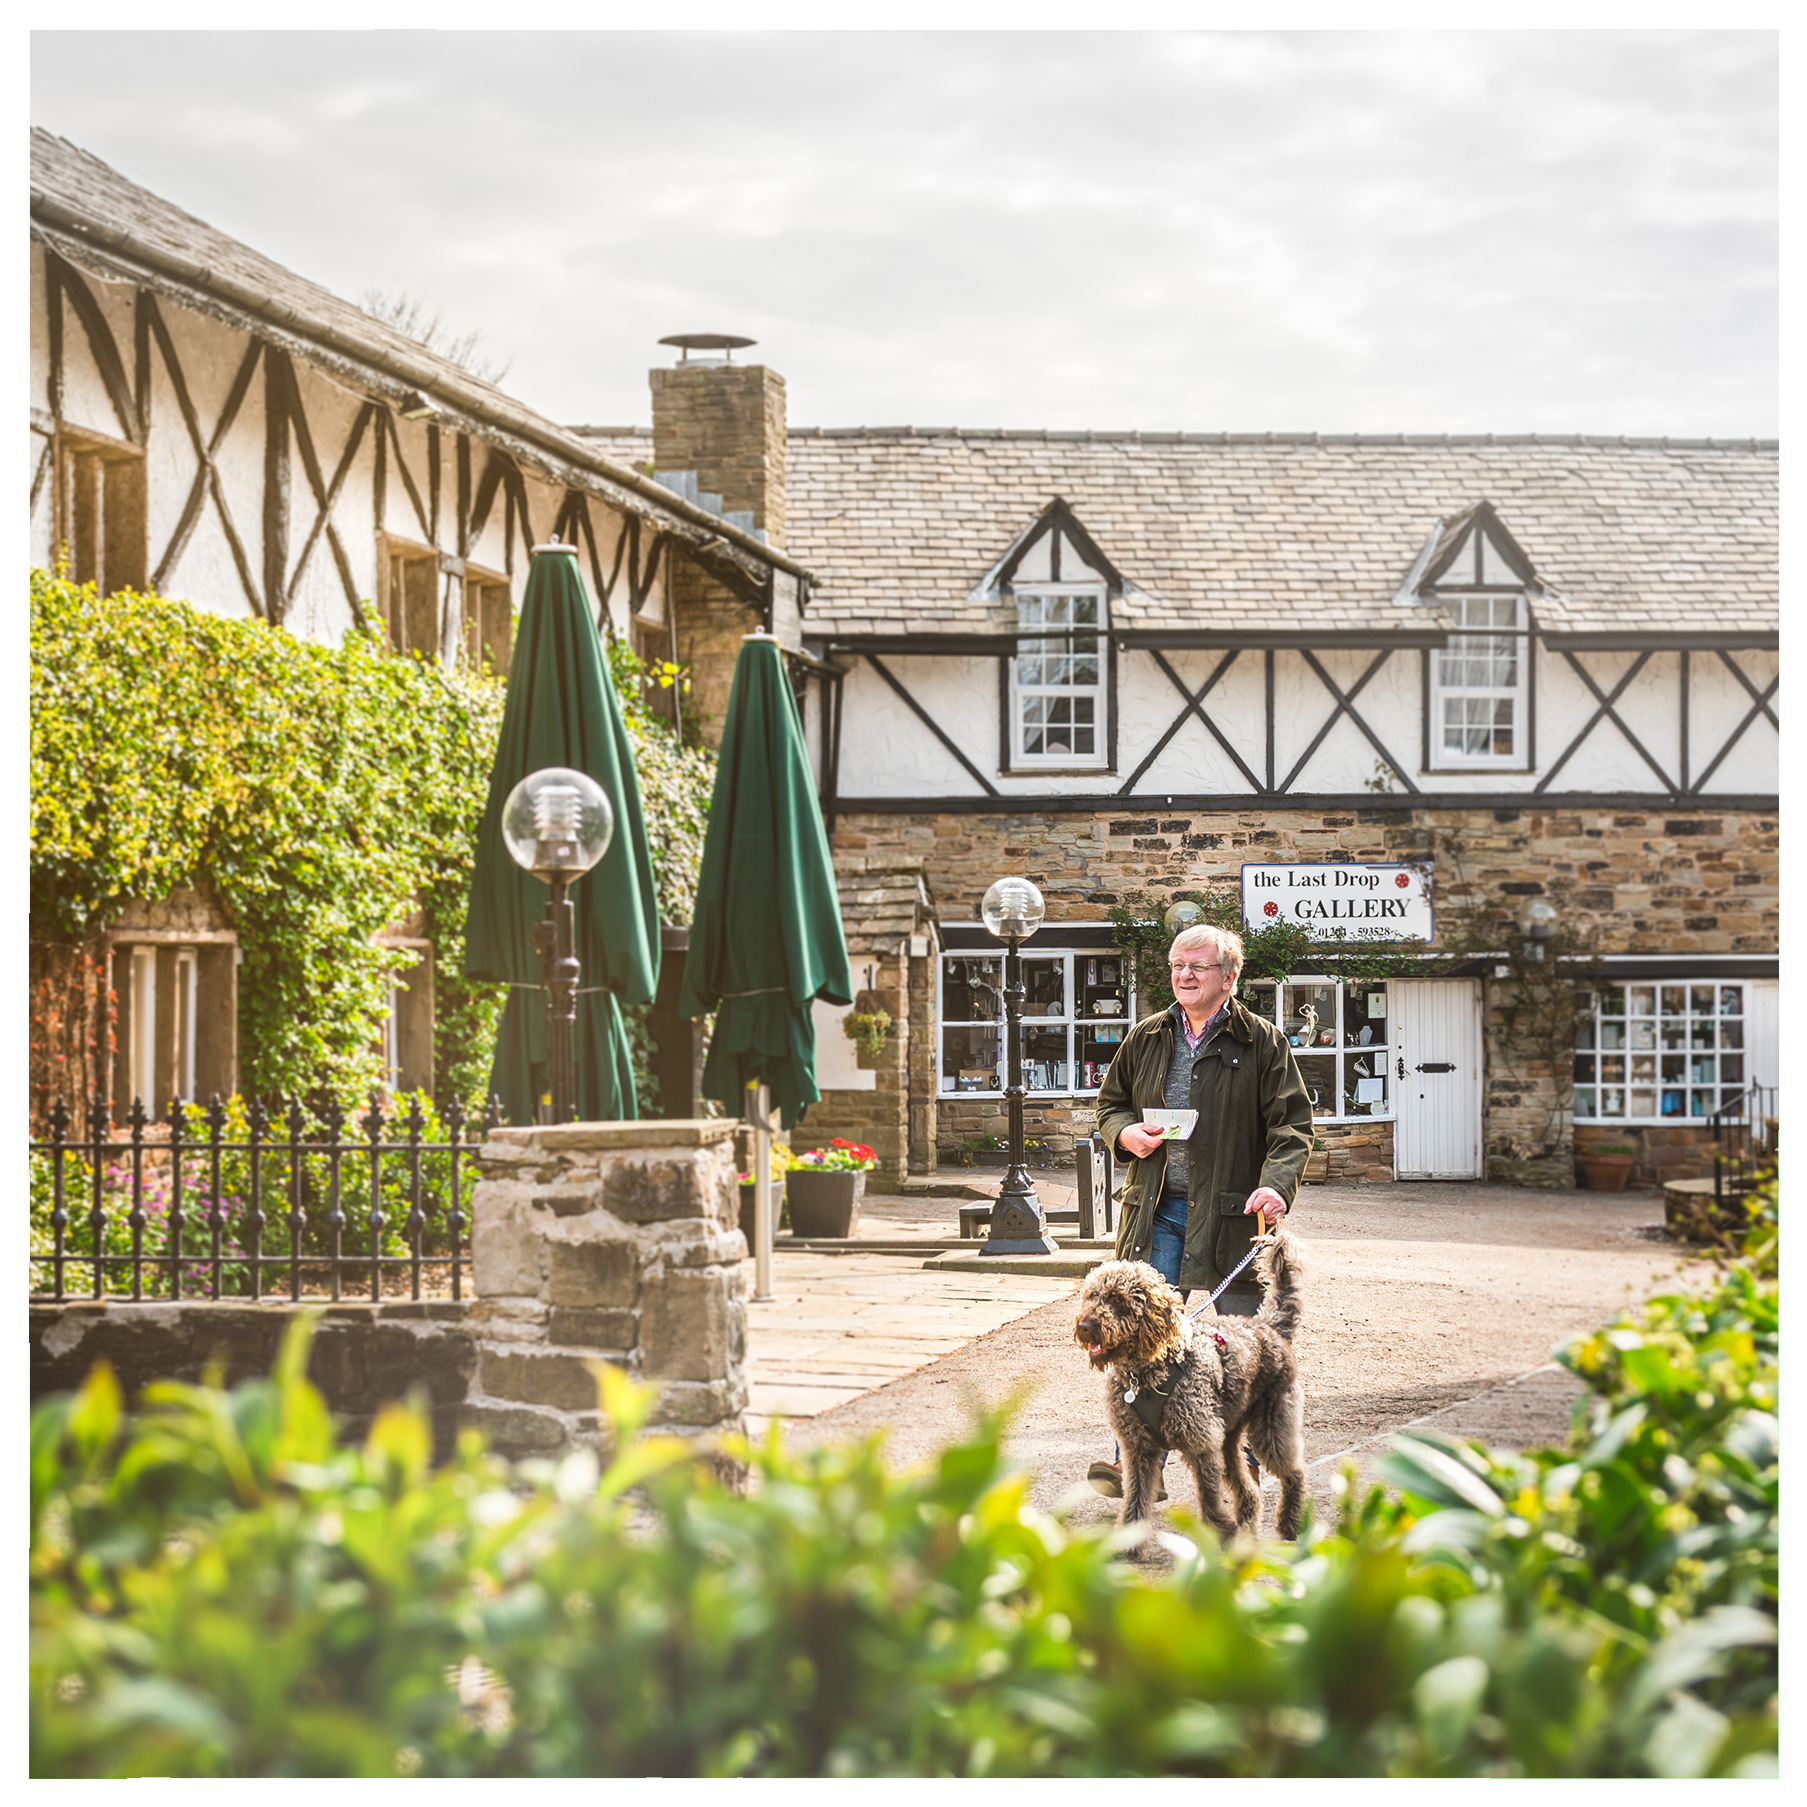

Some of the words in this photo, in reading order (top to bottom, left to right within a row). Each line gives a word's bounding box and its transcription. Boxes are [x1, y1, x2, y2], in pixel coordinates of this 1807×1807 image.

[1254, 871, 1281, 887] the
[1288, 870, 1327, 887] Last
[1334, 870, 1380, 890] Drop
[1294, 899, 1411, 919] GALLERY
[1357, 926, 1391, 937] 593528
